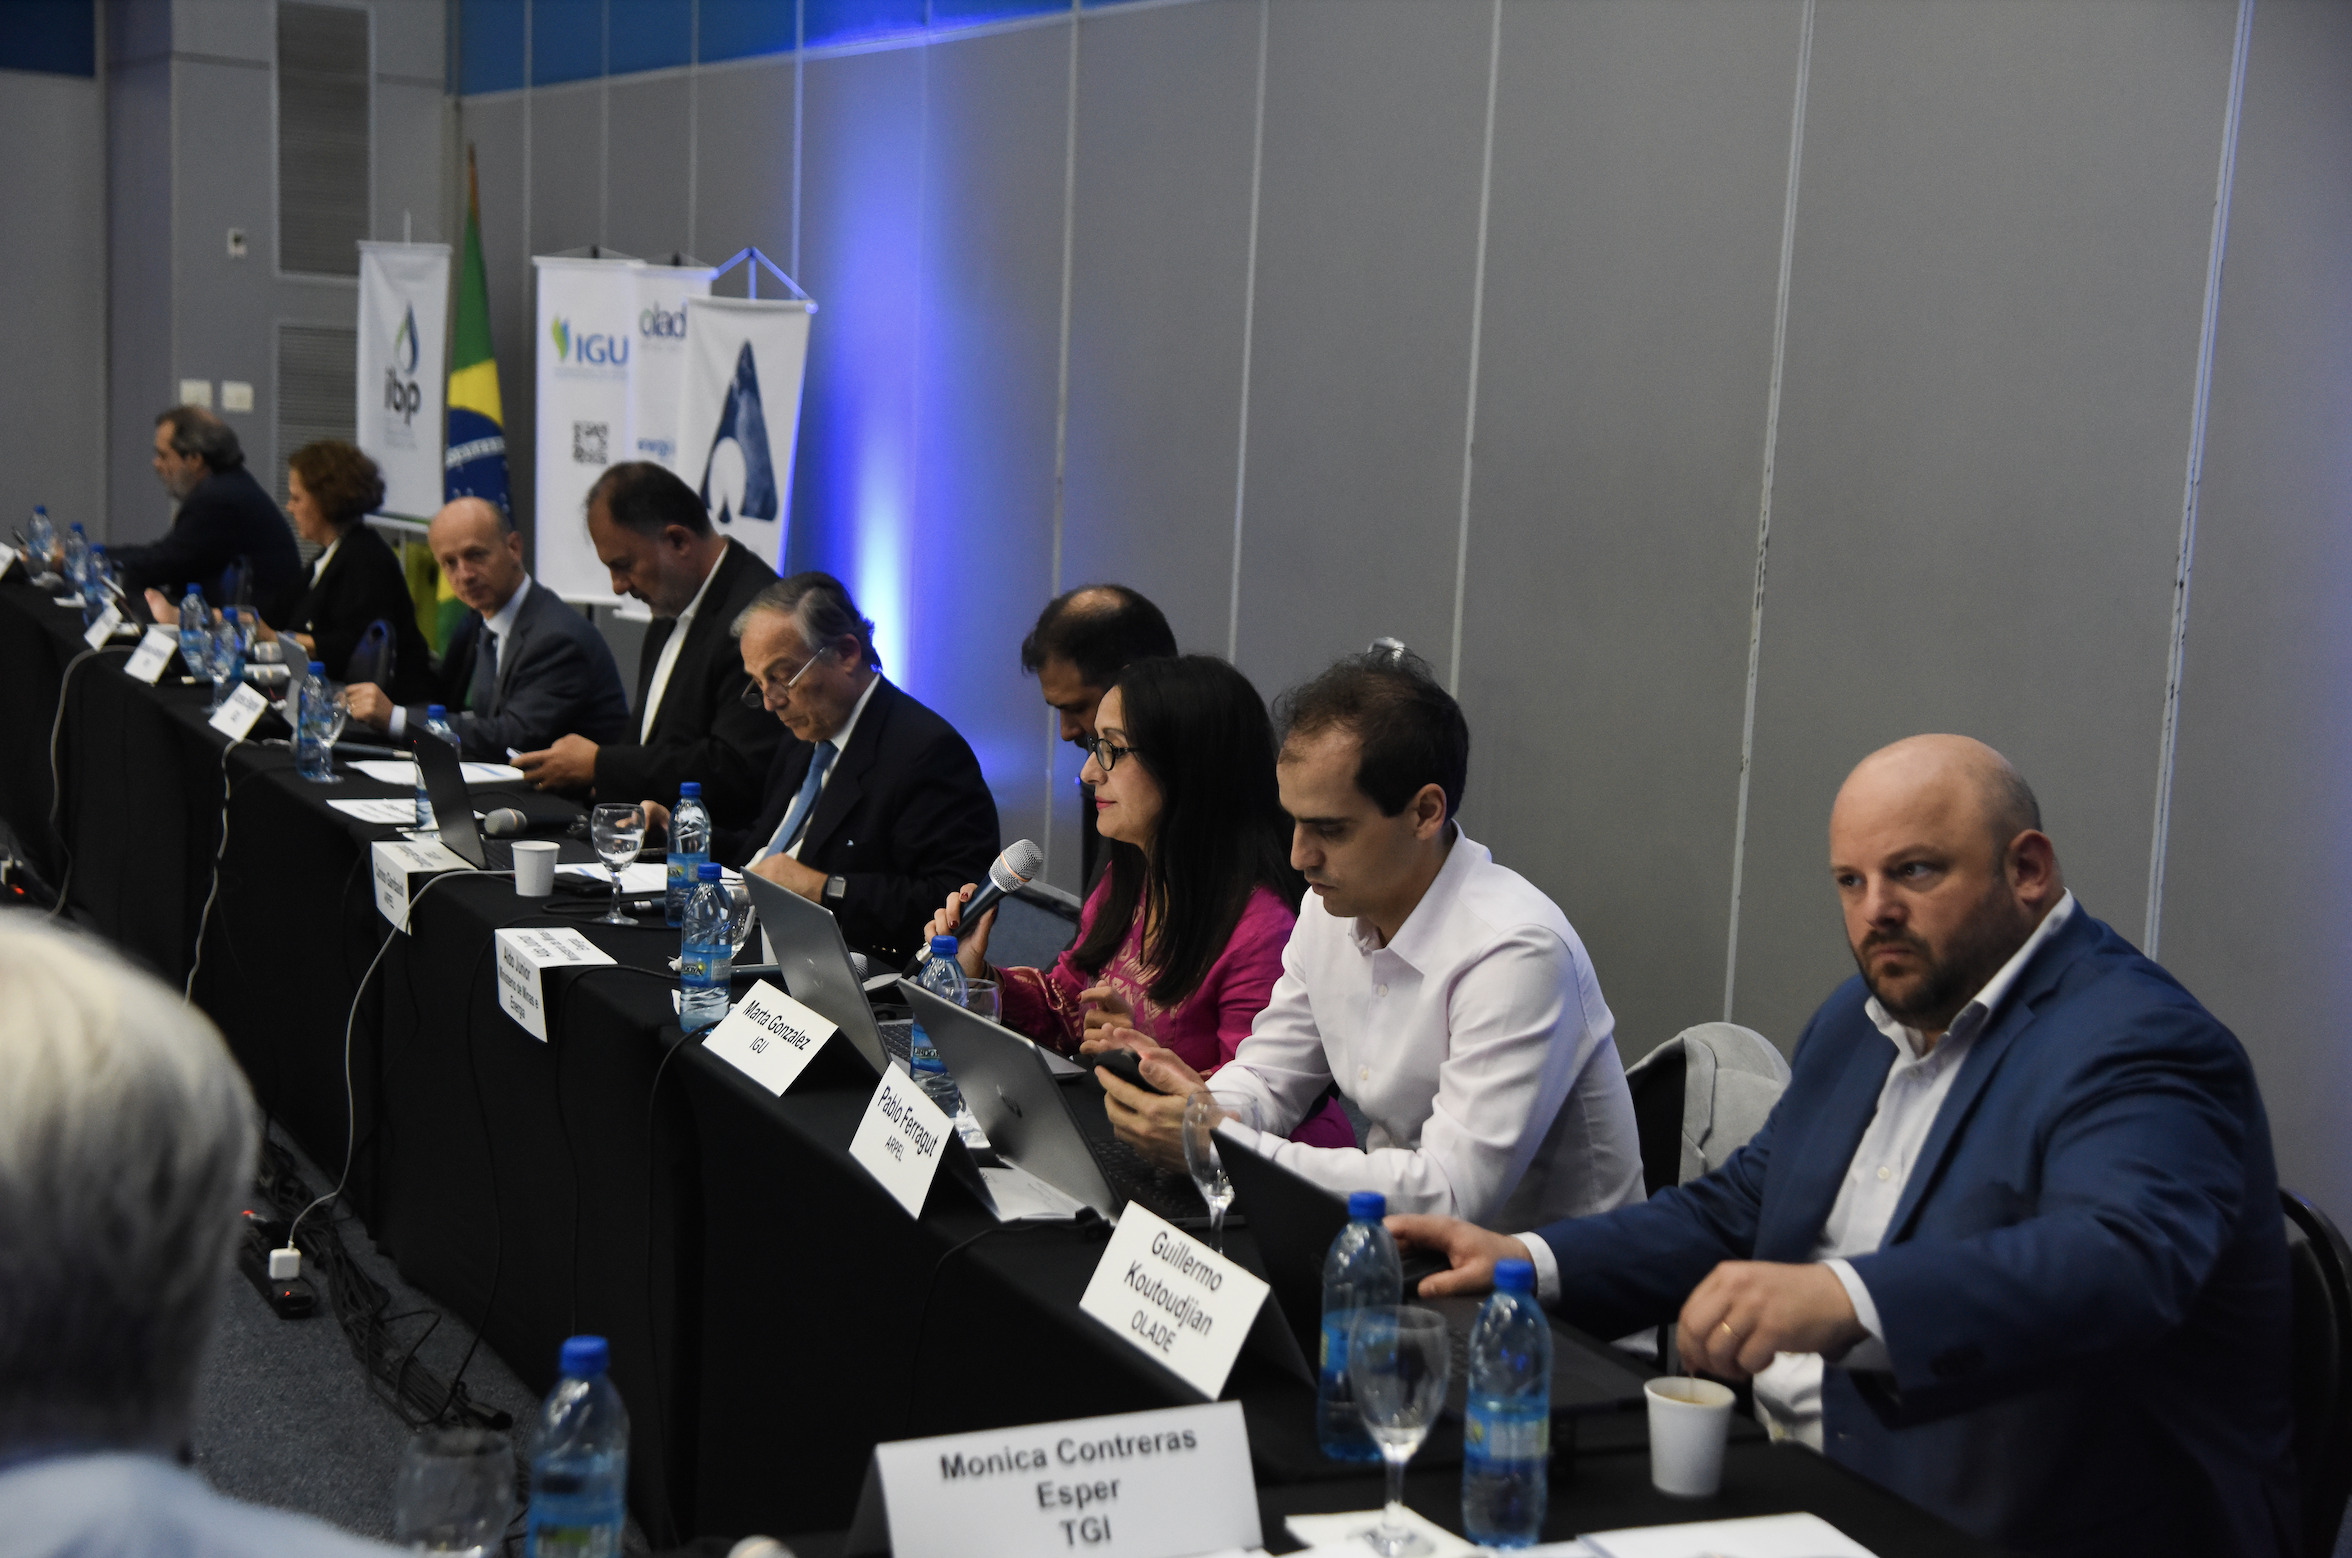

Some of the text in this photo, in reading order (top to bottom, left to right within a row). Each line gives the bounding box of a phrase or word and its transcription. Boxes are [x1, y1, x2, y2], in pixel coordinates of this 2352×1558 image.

[640, 300, 688, 339] olad
[576, 333, 630, 366] IGU
[385, 365, 421, 426] ibp
[743, 1000, 811, 1050] Marta Gonzalez
[749, 1036, 769, 1054] IGU
[878, 1085, 939, 1157] Pablo Ferragut
[885, 1135, 904, 1162] ARPEL
[1151, 1230, 1222, 1291] Guillermo
[1124, 1260, 1213, 1336] Koutoudjian
[1131, 1310, 1177, 1352] OLADE
[940, 1429, 1197, 1479] Monica Contreras
[1036, 1479, 1120, 1509] Esper
[1060, 1516, 1111, 1547] TGI
